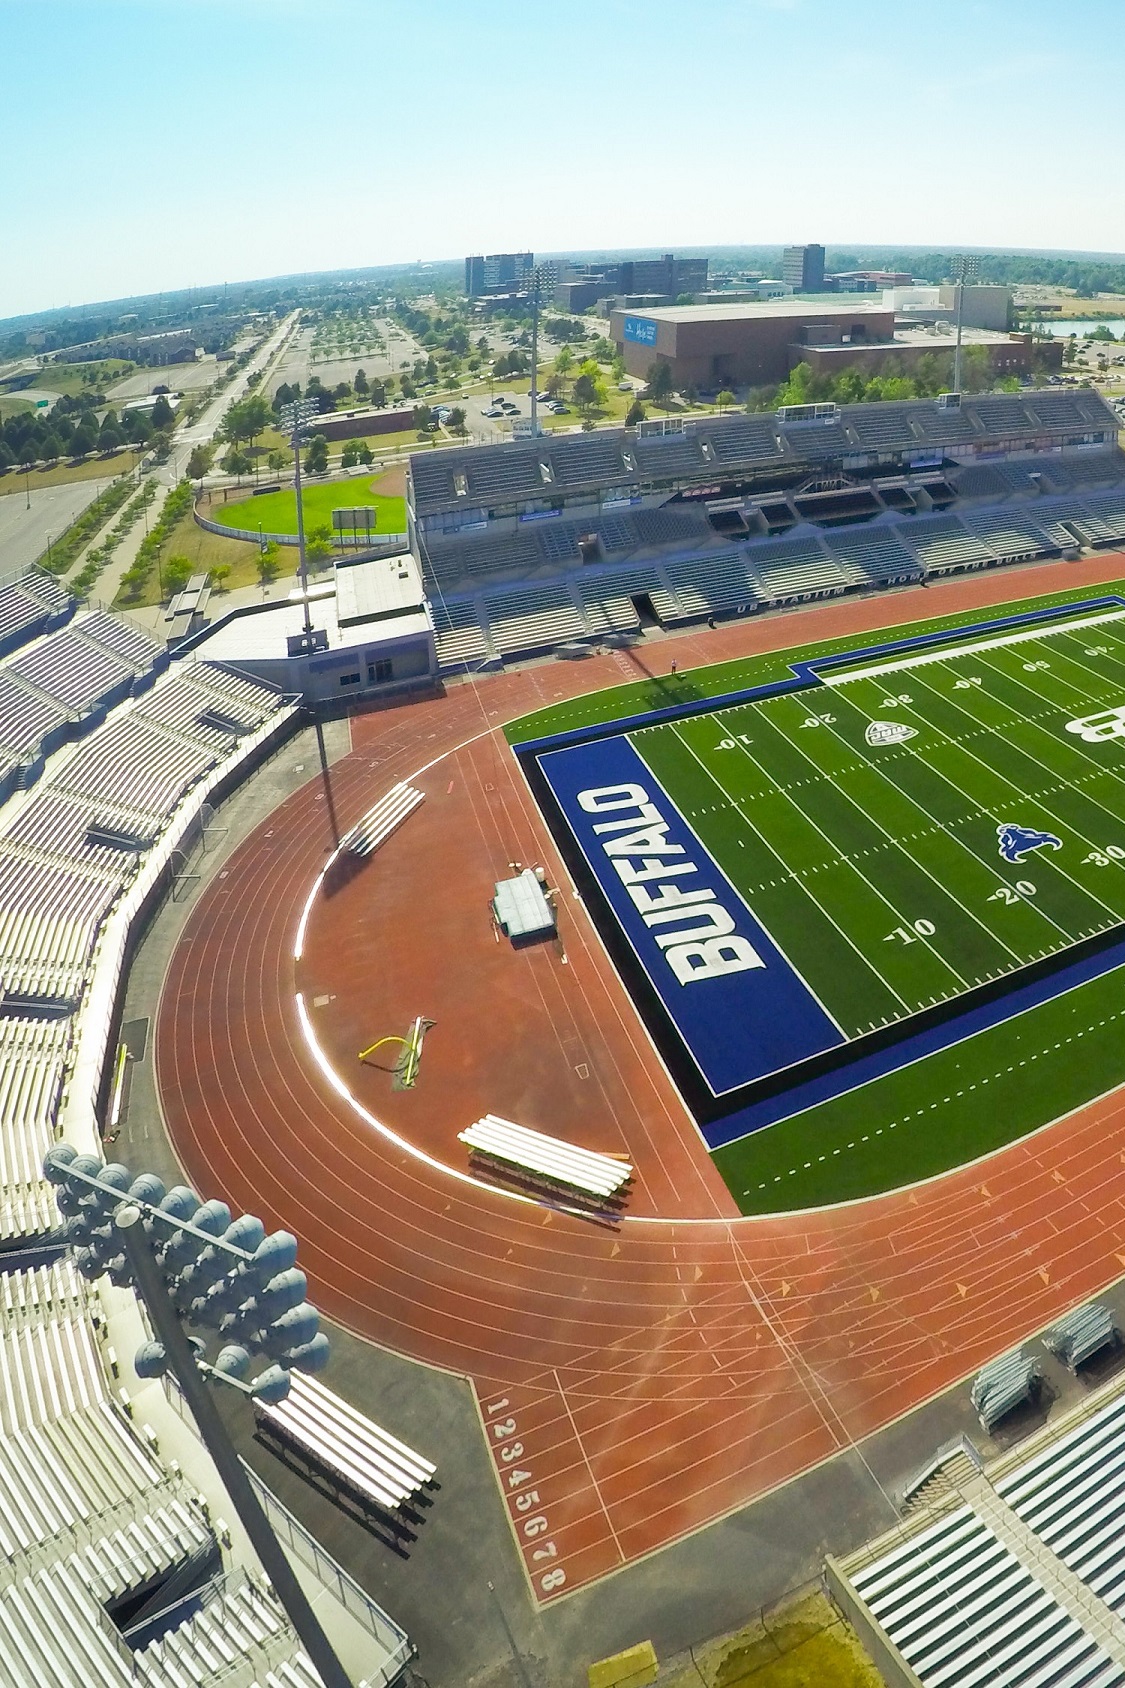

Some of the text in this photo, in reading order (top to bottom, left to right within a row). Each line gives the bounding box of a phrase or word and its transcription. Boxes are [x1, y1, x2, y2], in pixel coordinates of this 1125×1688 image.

[887, 553, 1037, 586] HOME OF THE BULLS
[737, 587, 846, 614] UB STADIUM
[1023, 660, 1051, 673] 50
[956, 677, 982, 690] 40
[884, 694, 914, 708] 30
[805, 713, 837, 728] 20
[720, 734, 754, 750] 10
[1088, 845, 1125, 867] 30
[577, 783, 767, 986] BUFFALO
[995, 880, 1037, 905] 20
[892, 919, 936, 945] 10
[487, 1398, 510, 1415] 1
[493, 1418, 517, 1439] 2
[501, 1442, 524, 1462] 3
[508, 1469, 532, 1488] 4
[515, 1490, 541, 1512] 5
[523, 1515, 548, 1537] 6
[532, 1542, 558, 1562] 7
[540, 1568, 566, 1592] 8
